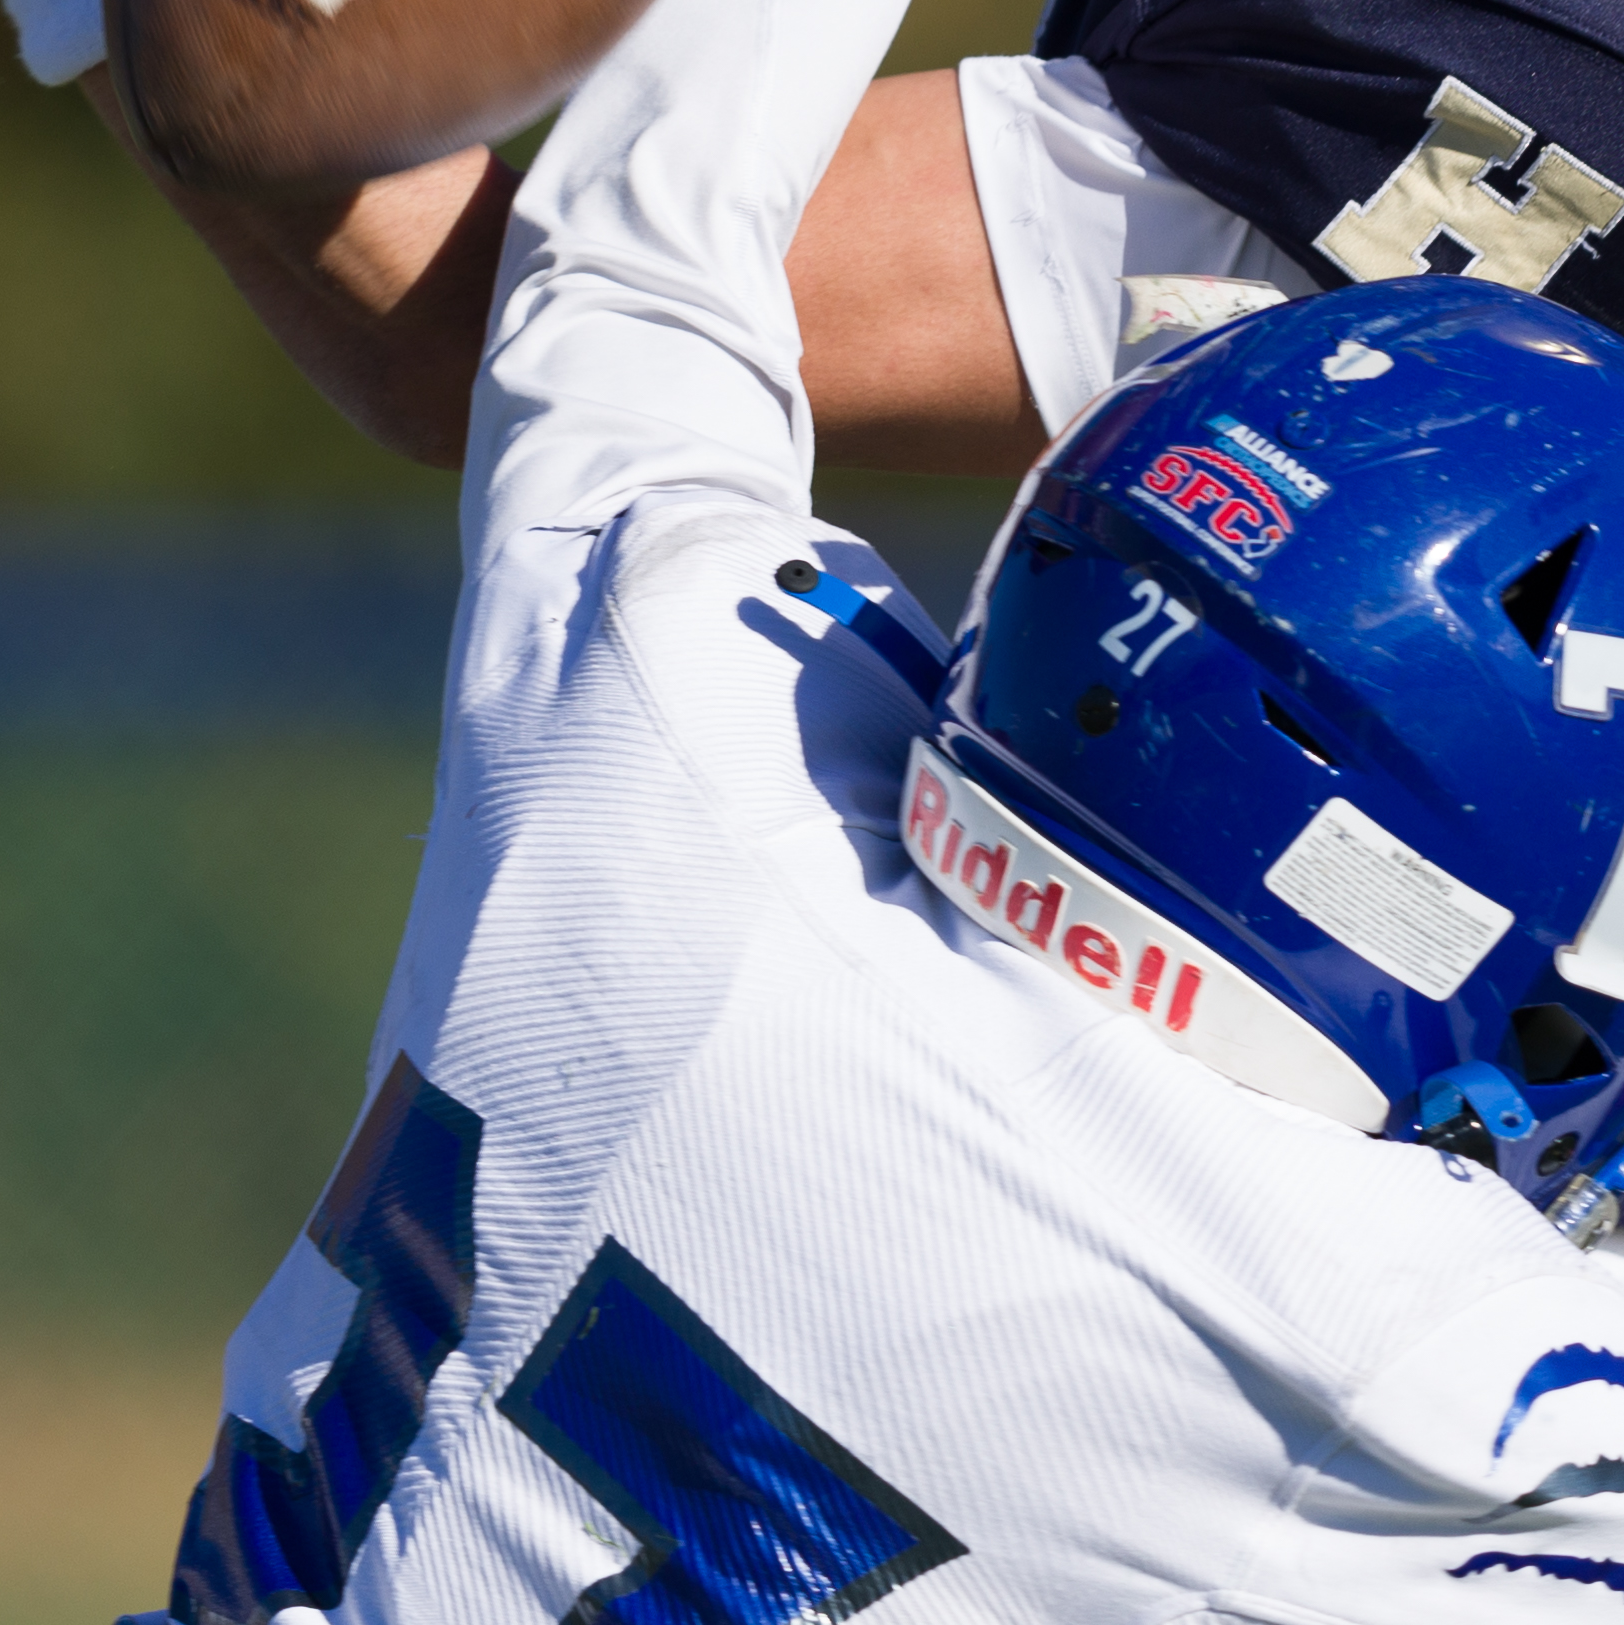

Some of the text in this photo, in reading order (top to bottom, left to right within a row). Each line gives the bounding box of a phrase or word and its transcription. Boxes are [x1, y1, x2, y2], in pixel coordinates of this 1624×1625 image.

[1141, 453, 1265, 544] SFC
[1223, 424, 1332, 500] ALLIANCE
[1098, 579, 1198, 677] 27
[908, 762, 1206, 1033] Riddell
